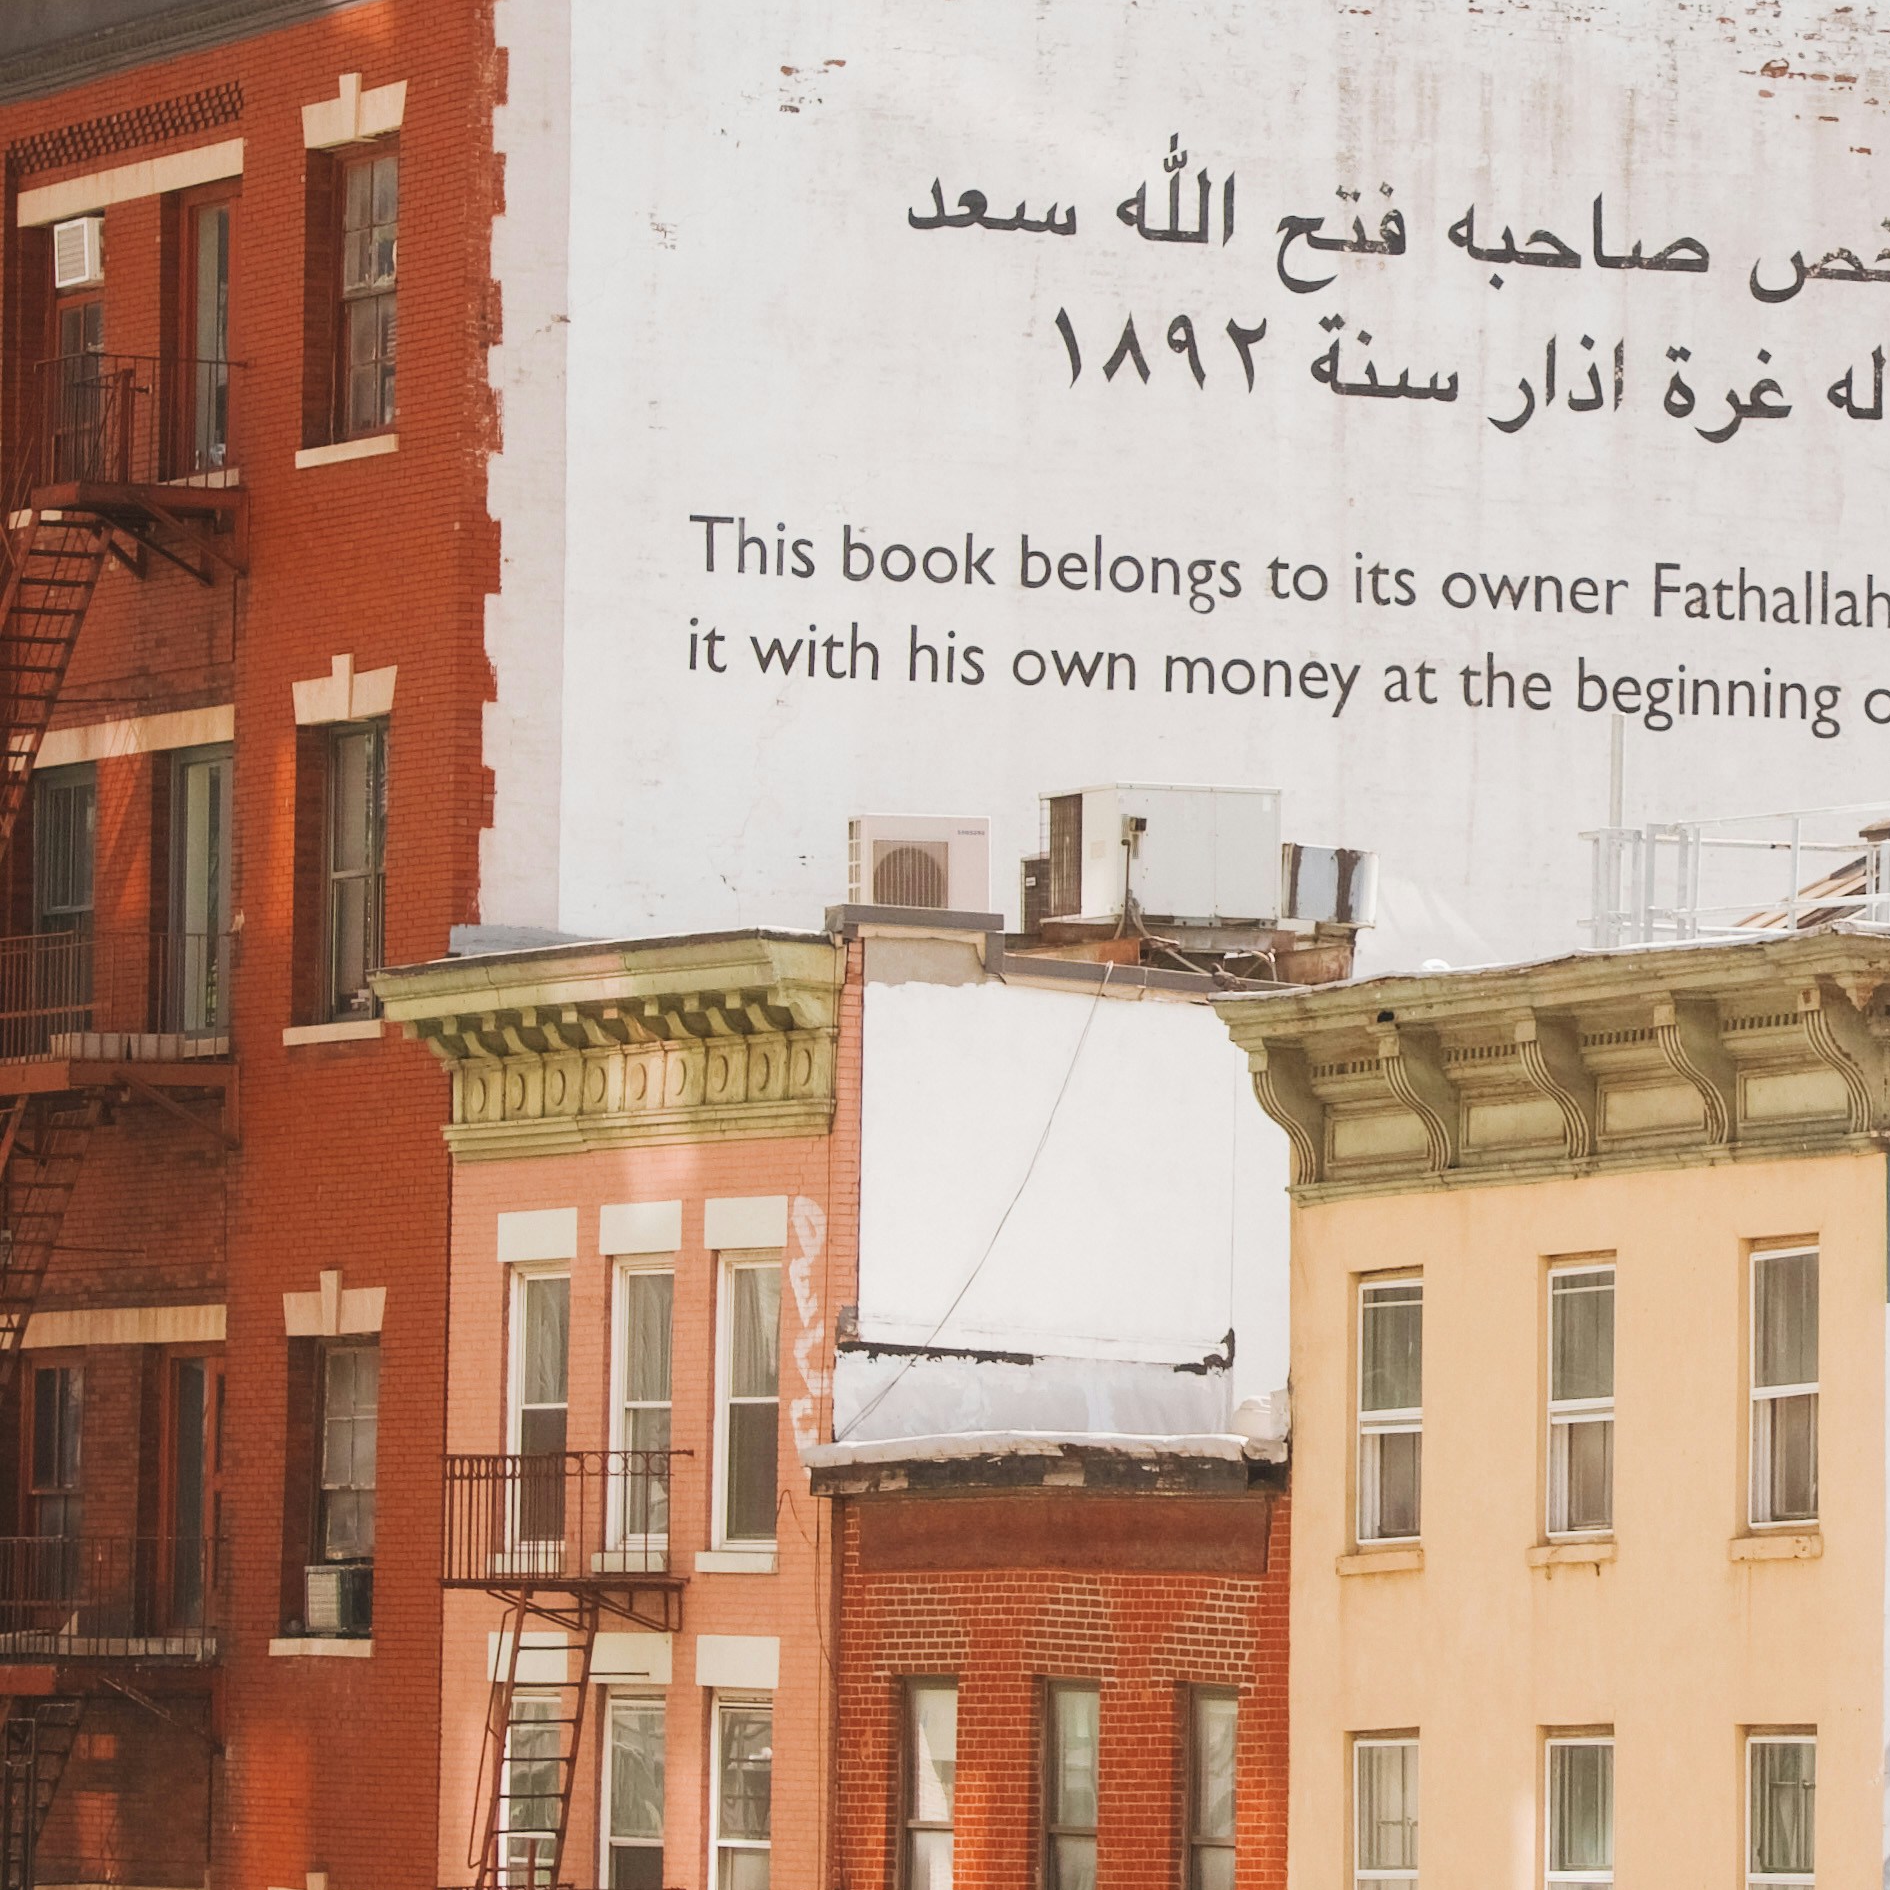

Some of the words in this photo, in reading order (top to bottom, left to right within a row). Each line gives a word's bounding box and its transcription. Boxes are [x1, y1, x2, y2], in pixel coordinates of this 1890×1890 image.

[908, 177, 1077, 236] سعد
[1116, 133, 1236, 246] الله
[1276, 181, 1407, 294] فتح
[1447, 191, 1709, 290] صاحبه
[1055, 306, 1267, 394] ١٨٩٢
[1310, 313, 1459, 402] سنة
[1488, 334, 1624, 434] اذار
[1663, 345, 1793, 444] غرة
[689, 514, 815, 579] This
[842, 524, 997, 588] book
[1020, 533, 1242, 615] belongs
[1268, 556, 1329, 603] to
[1355, 552, 1417, 608] its
[1442, 570, 1629, 616] owner
[689, 617, 728, 673] it
[750, 621, 879, 681] with
[909, 624, 985, 686] his
[1012, 648, 1136, 691] own
[1165, 655, 1361, 718] money
[1384, 662, 1438, 705] at
[1460, 651, 1552, 711] the
[1577, 656, 1841, 739] beginning
